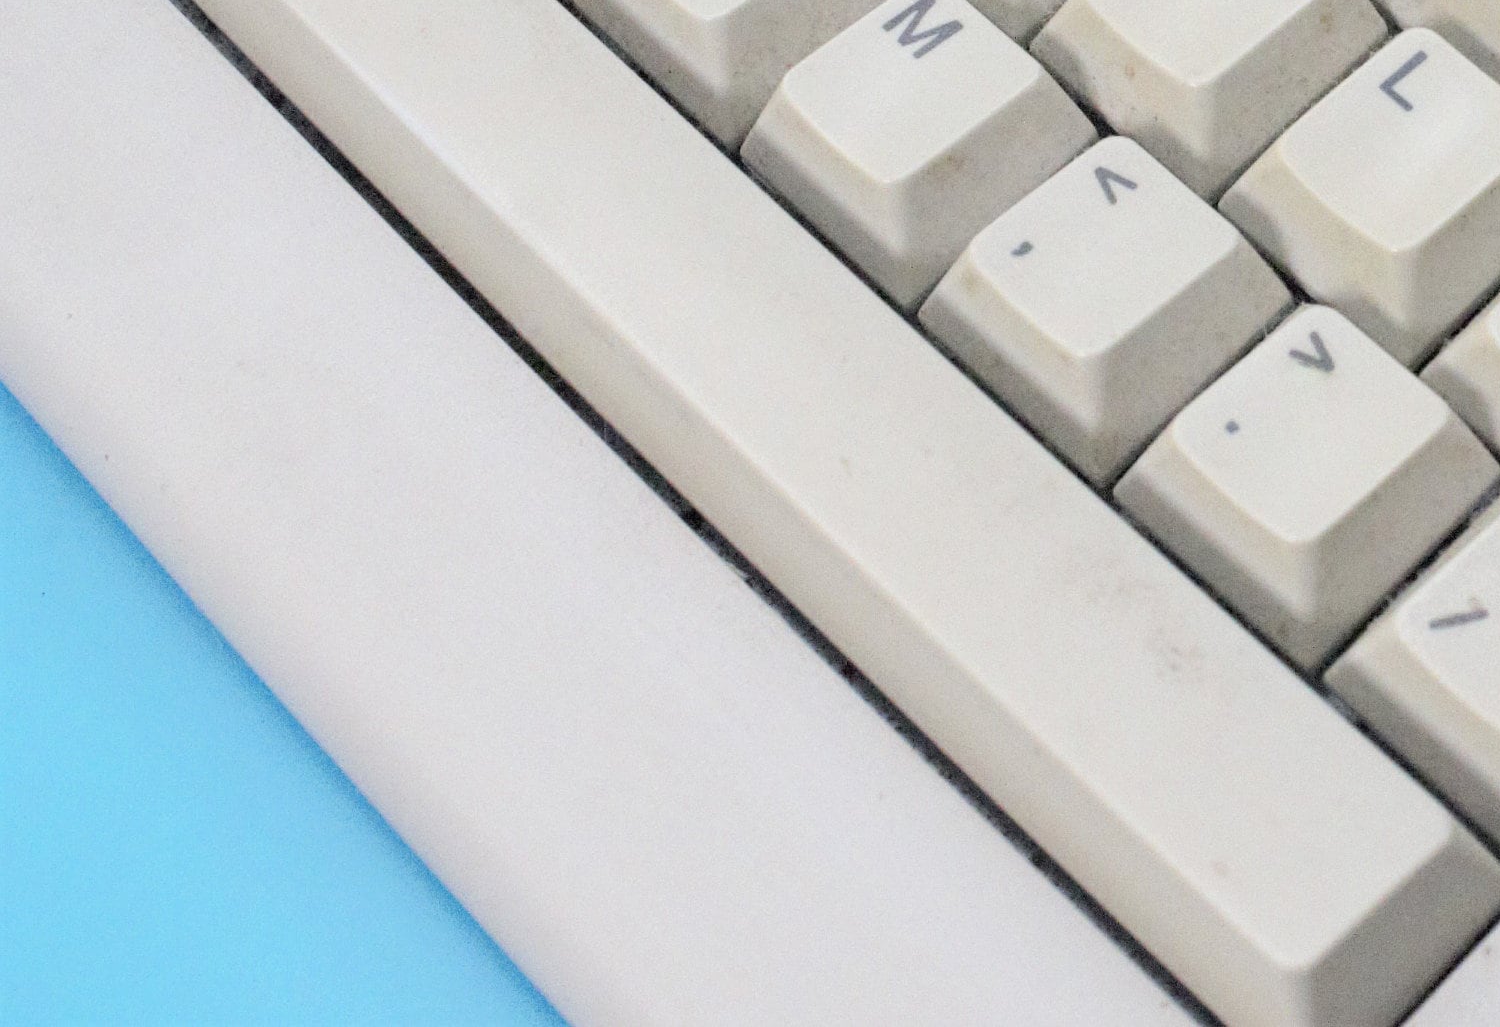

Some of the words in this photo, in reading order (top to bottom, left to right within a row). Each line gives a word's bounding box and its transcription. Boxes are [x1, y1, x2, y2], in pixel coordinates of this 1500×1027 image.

[1379, 50, 1428, 110] L
[1094, 167, 1137, 204] <
[1290, 332, 1334, 373] >
